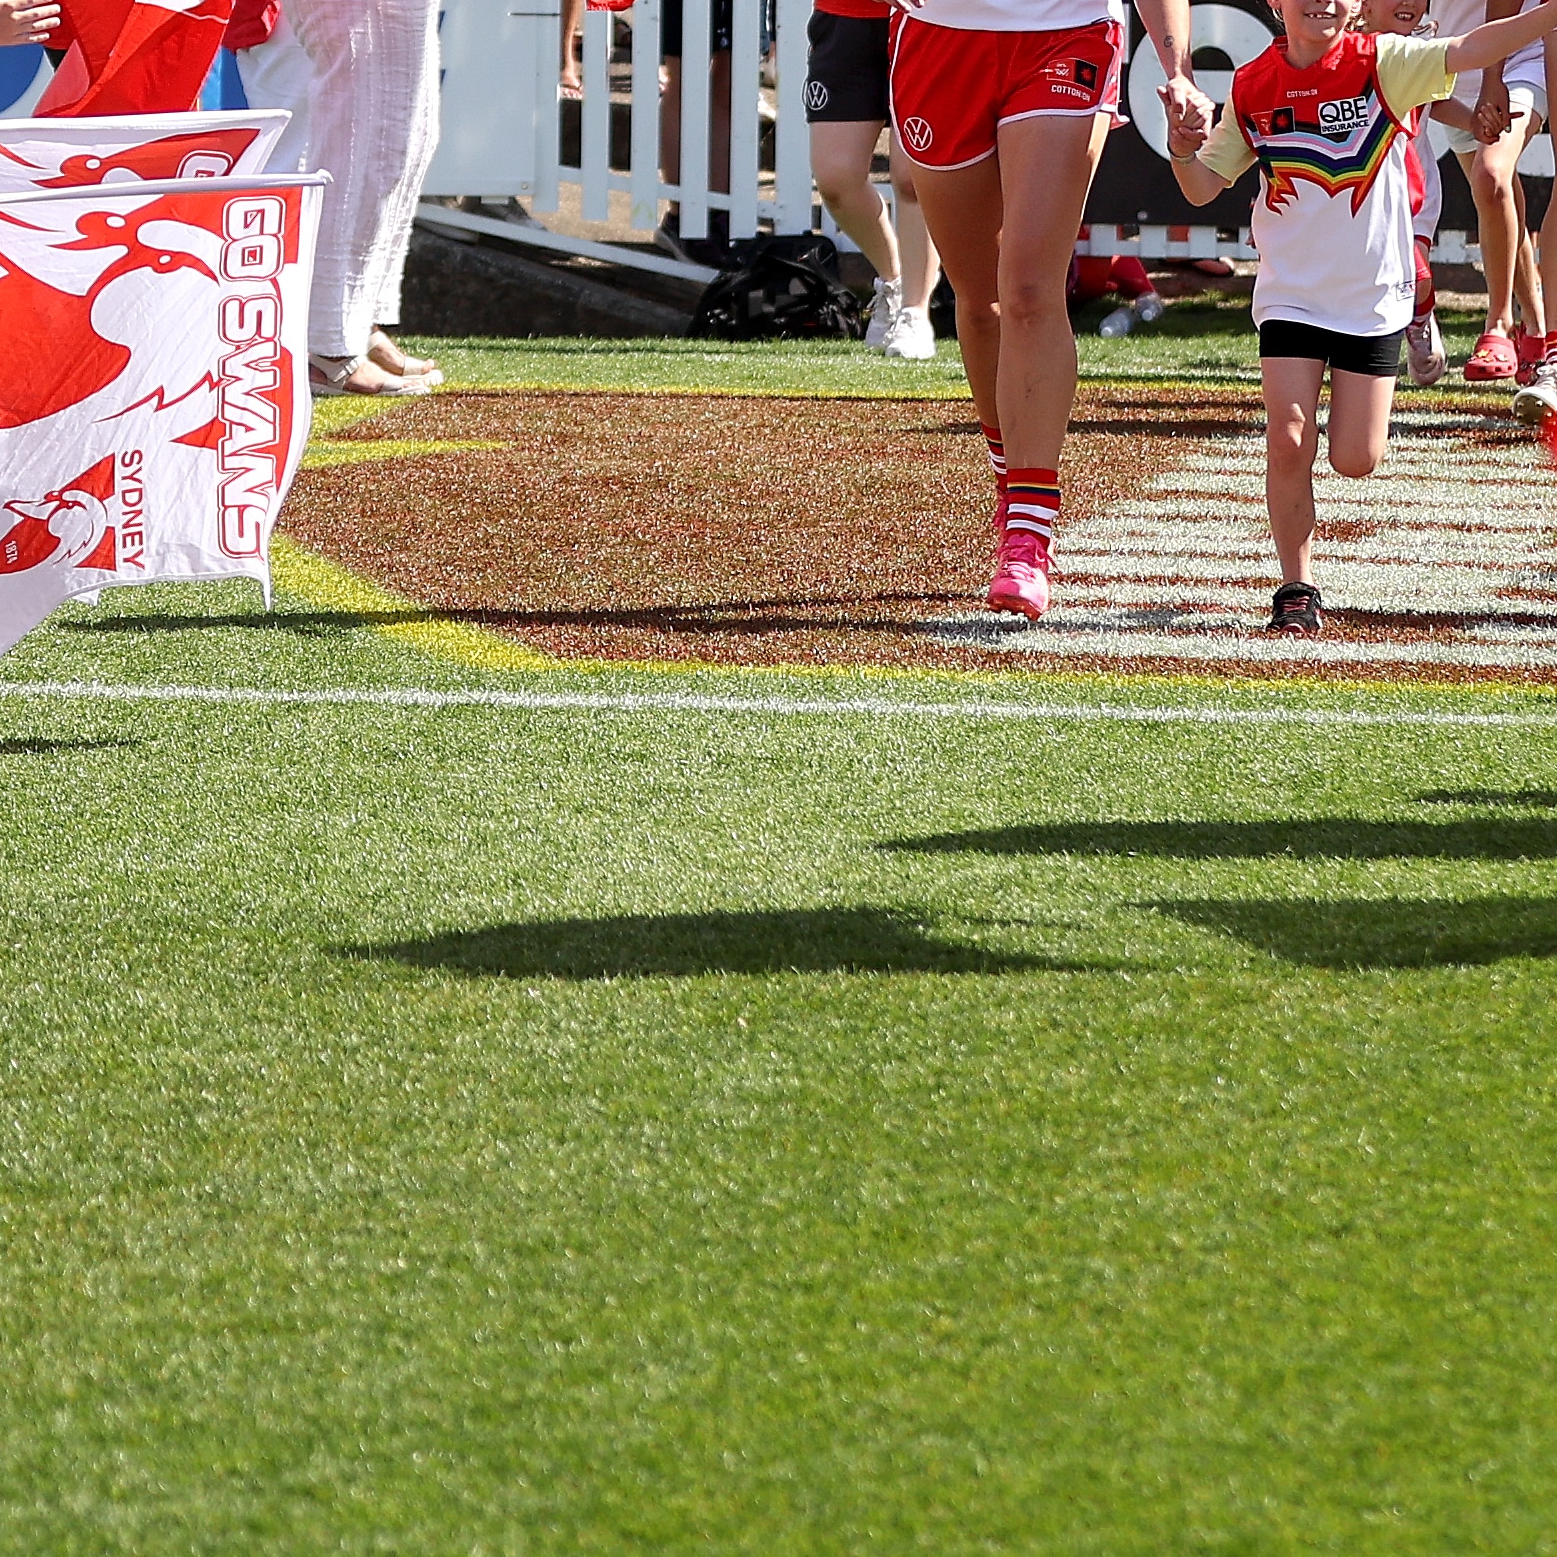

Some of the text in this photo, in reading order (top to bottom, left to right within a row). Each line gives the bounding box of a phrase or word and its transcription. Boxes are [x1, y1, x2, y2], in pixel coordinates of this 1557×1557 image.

[1319, 97, 1369, 124] QBE
[1321, 119, 1370, 133] INSURANCE
[217, 196, 286, 562] GO SWANS
[120, 449, 146, 572] SYDNEY
[4, 539, 17, 565] 1874
